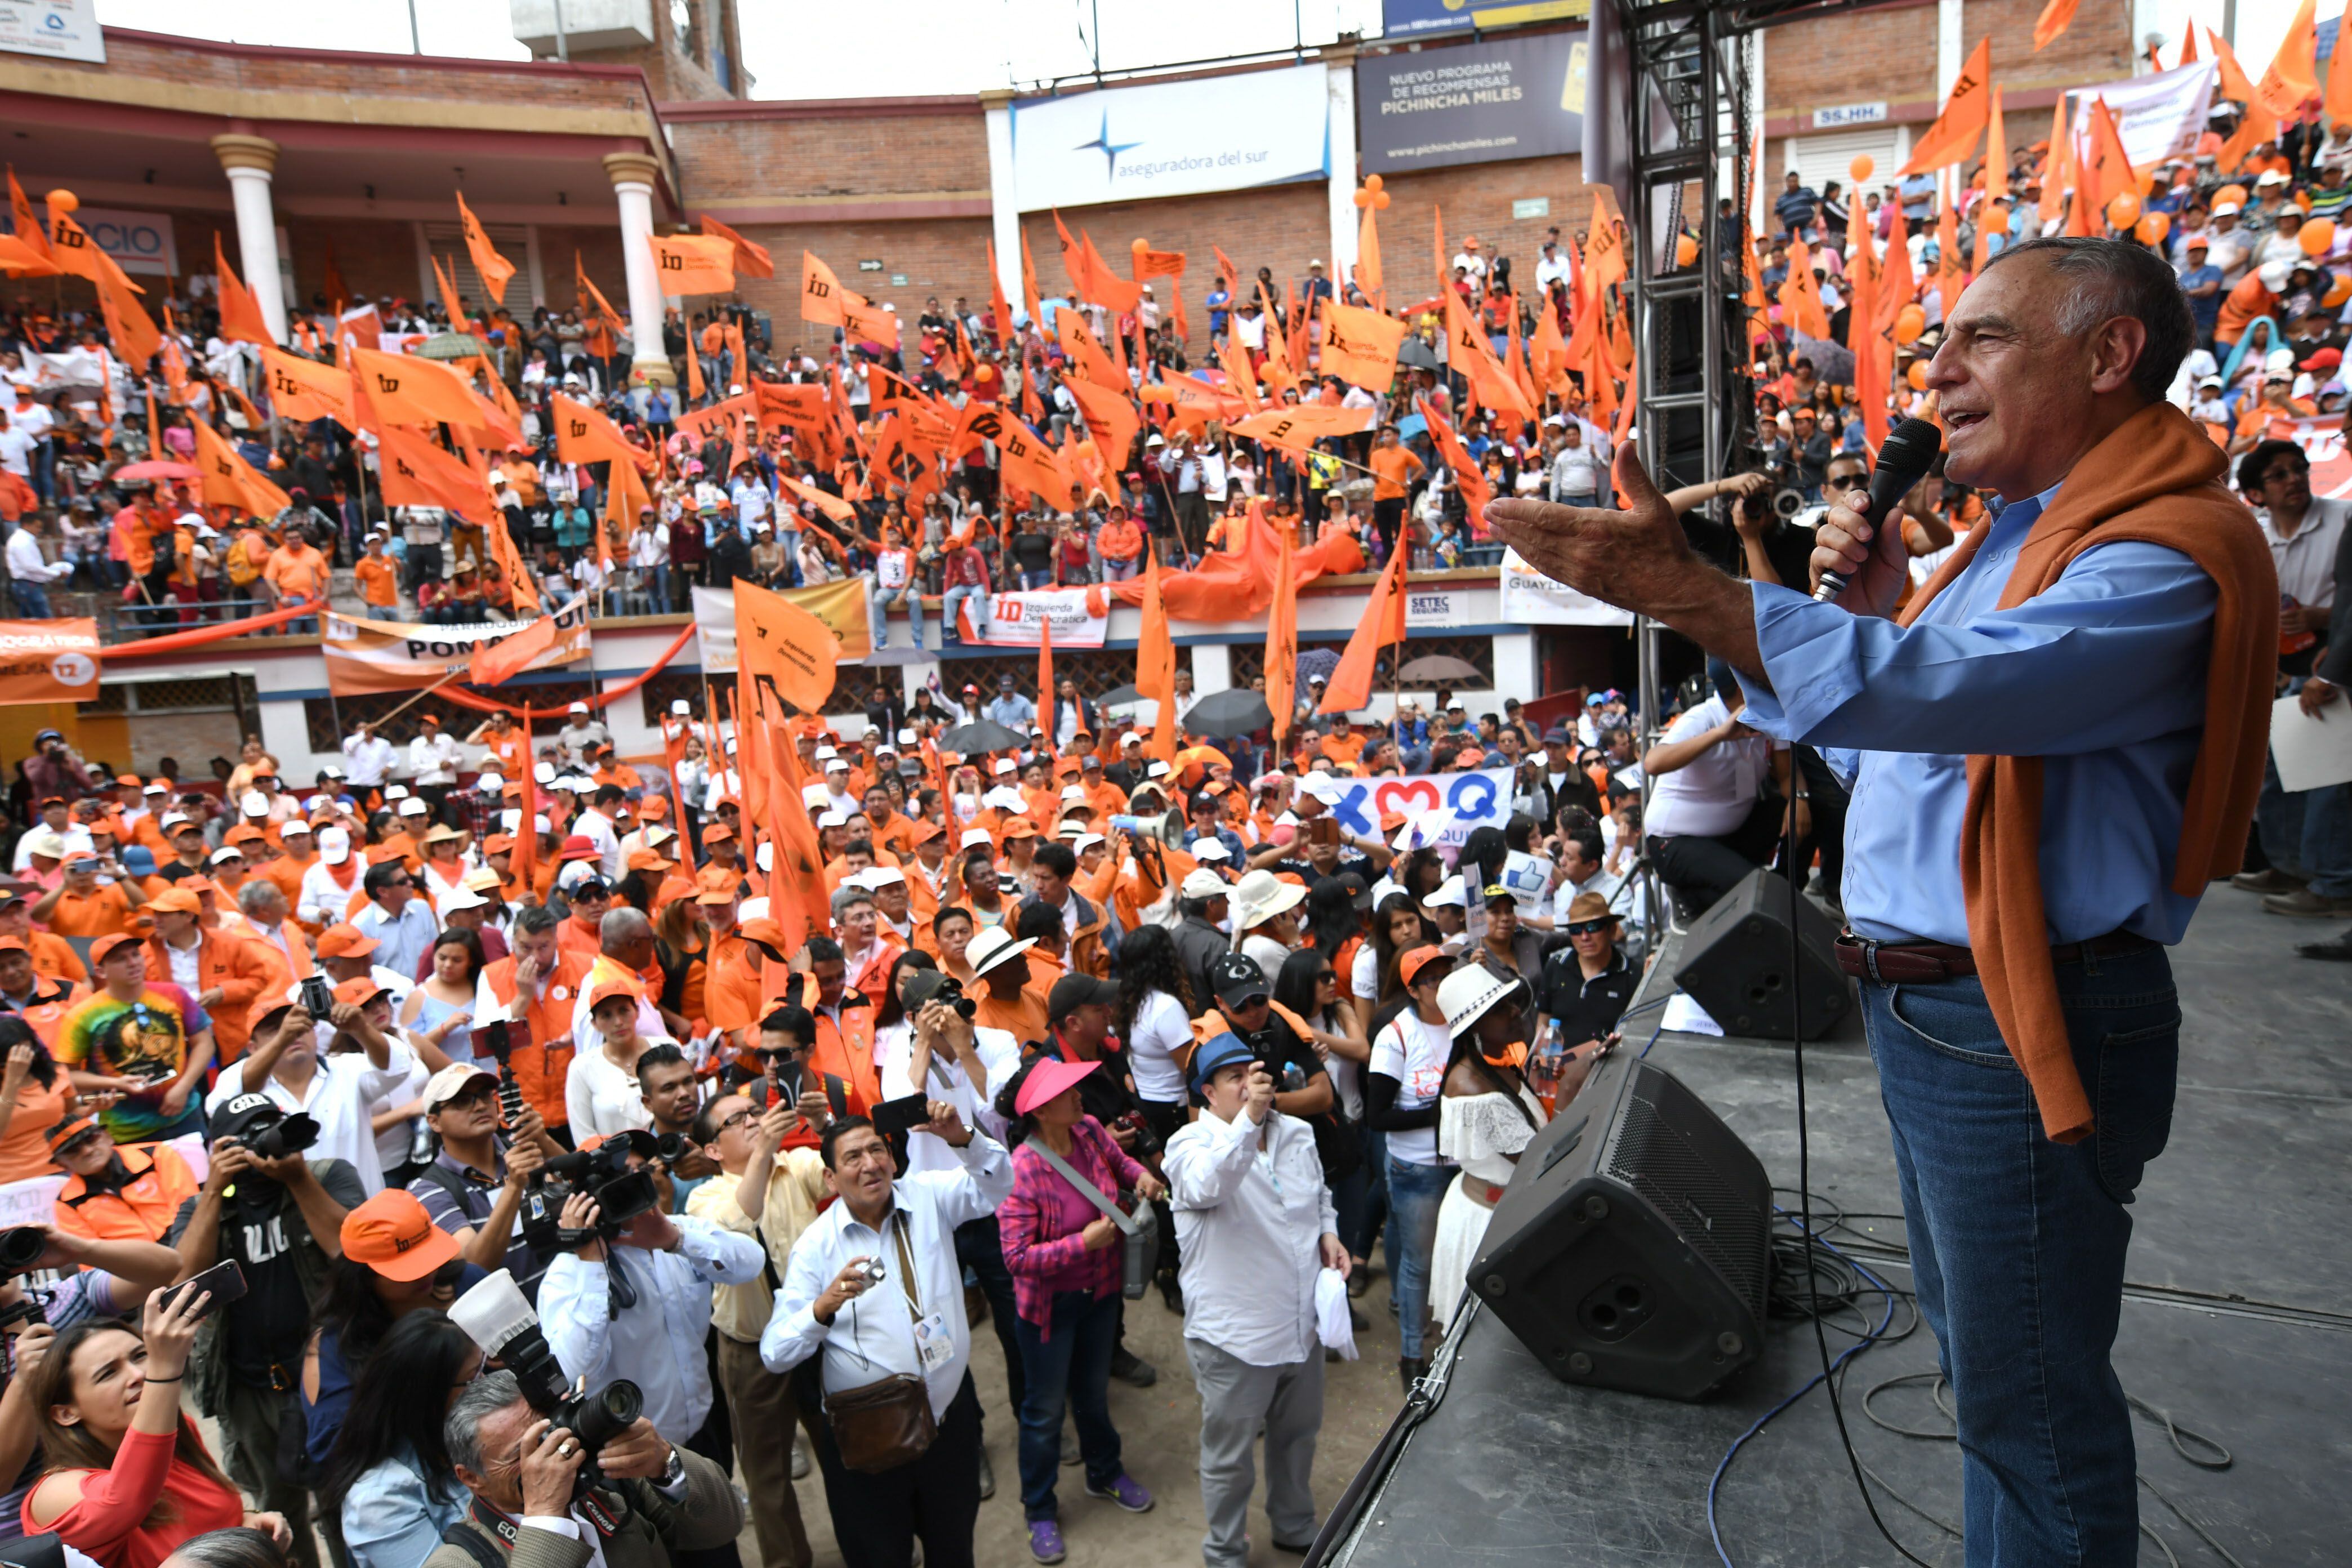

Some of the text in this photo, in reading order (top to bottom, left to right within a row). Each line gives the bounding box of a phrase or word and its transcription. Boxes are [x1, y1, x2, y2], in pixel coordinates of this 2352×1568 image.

[1389, 61, 1512, 86] NUEVO PROGRAMA
[1392, 74, 1510, 100] DE RECOMPENSAS
[1380, 86, 1523, 115] PICHINCHA MILES
[1387, 136, 1517, 158] www.pichinchamiles.com
[1119, 149, 1269, 179] aseguradora del sur
[1509, 576, 1573, 590] GUAYLL
[1026, 602, 1073, 613] Izquierda
[1411, 596, 1449, 608] SETEC
[1411, 607, 1450, 615] SEGUROS
[783, 638, 816, 663] Izquierda
[586, 1501, 616, 1531] Canon
[498, 1521, 520, 1543] EO
